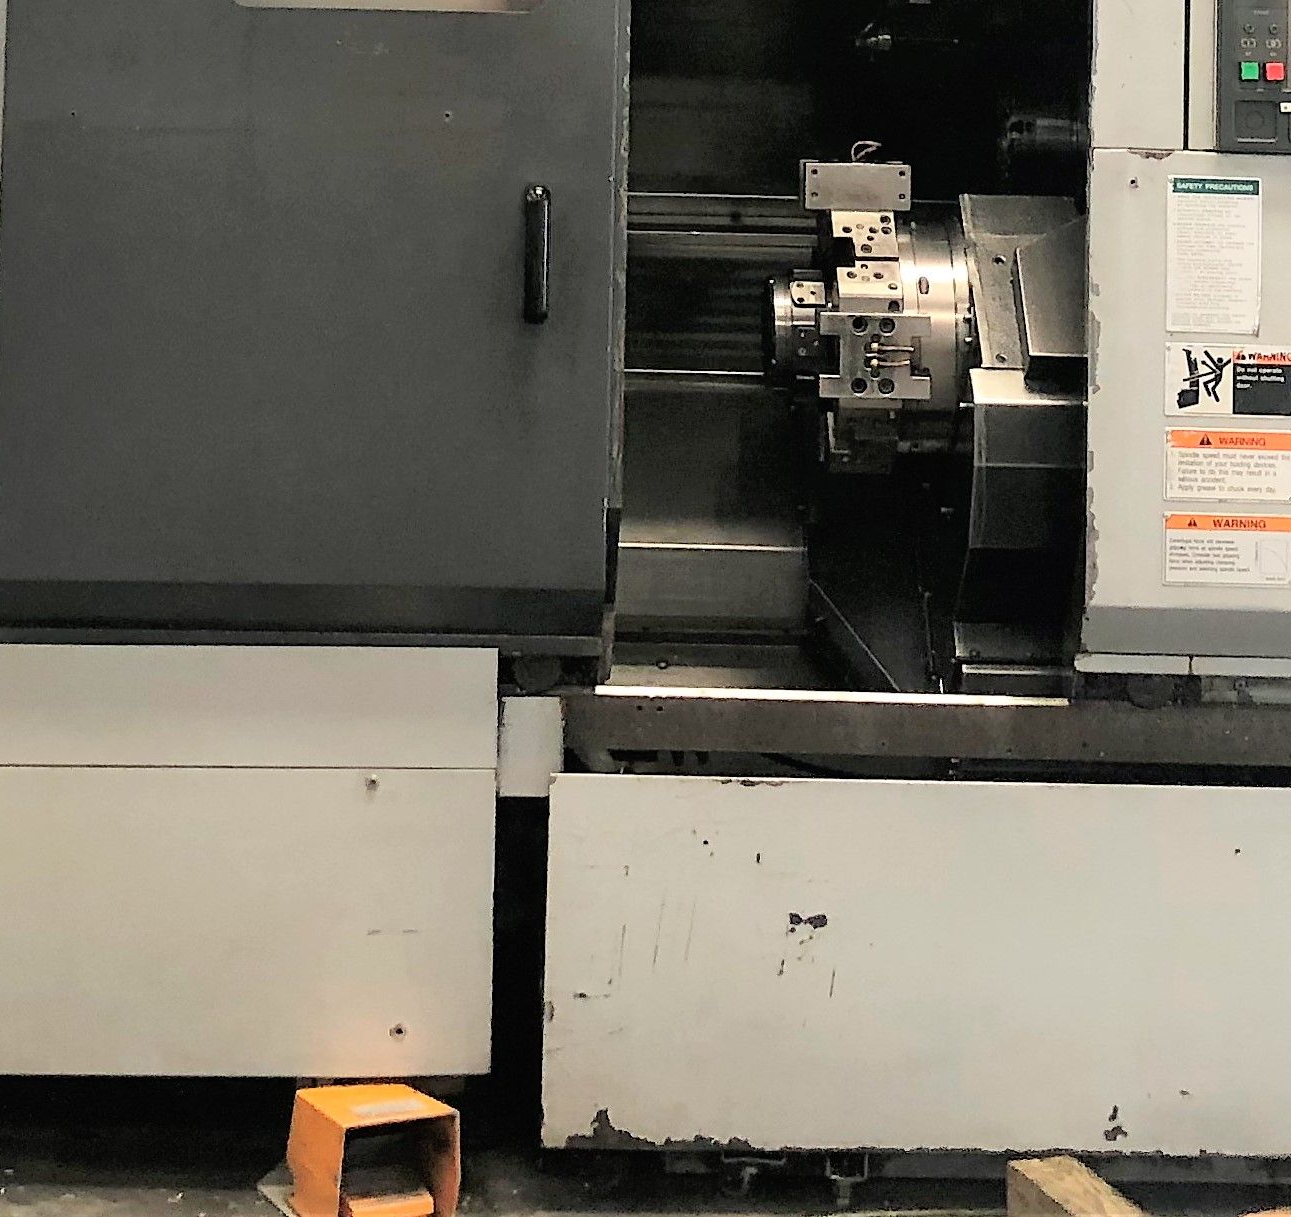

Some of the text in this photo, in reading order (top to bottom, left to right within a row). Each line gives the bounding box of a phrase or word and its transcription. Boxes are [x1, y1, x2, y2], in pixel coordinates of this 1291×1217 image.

[1176, 182, 1254, 192] SAFETY PRECAUTIONS
[1218, 437, 1266, 446] WARNING
[1213, 519, 1267, 529] WARNING
